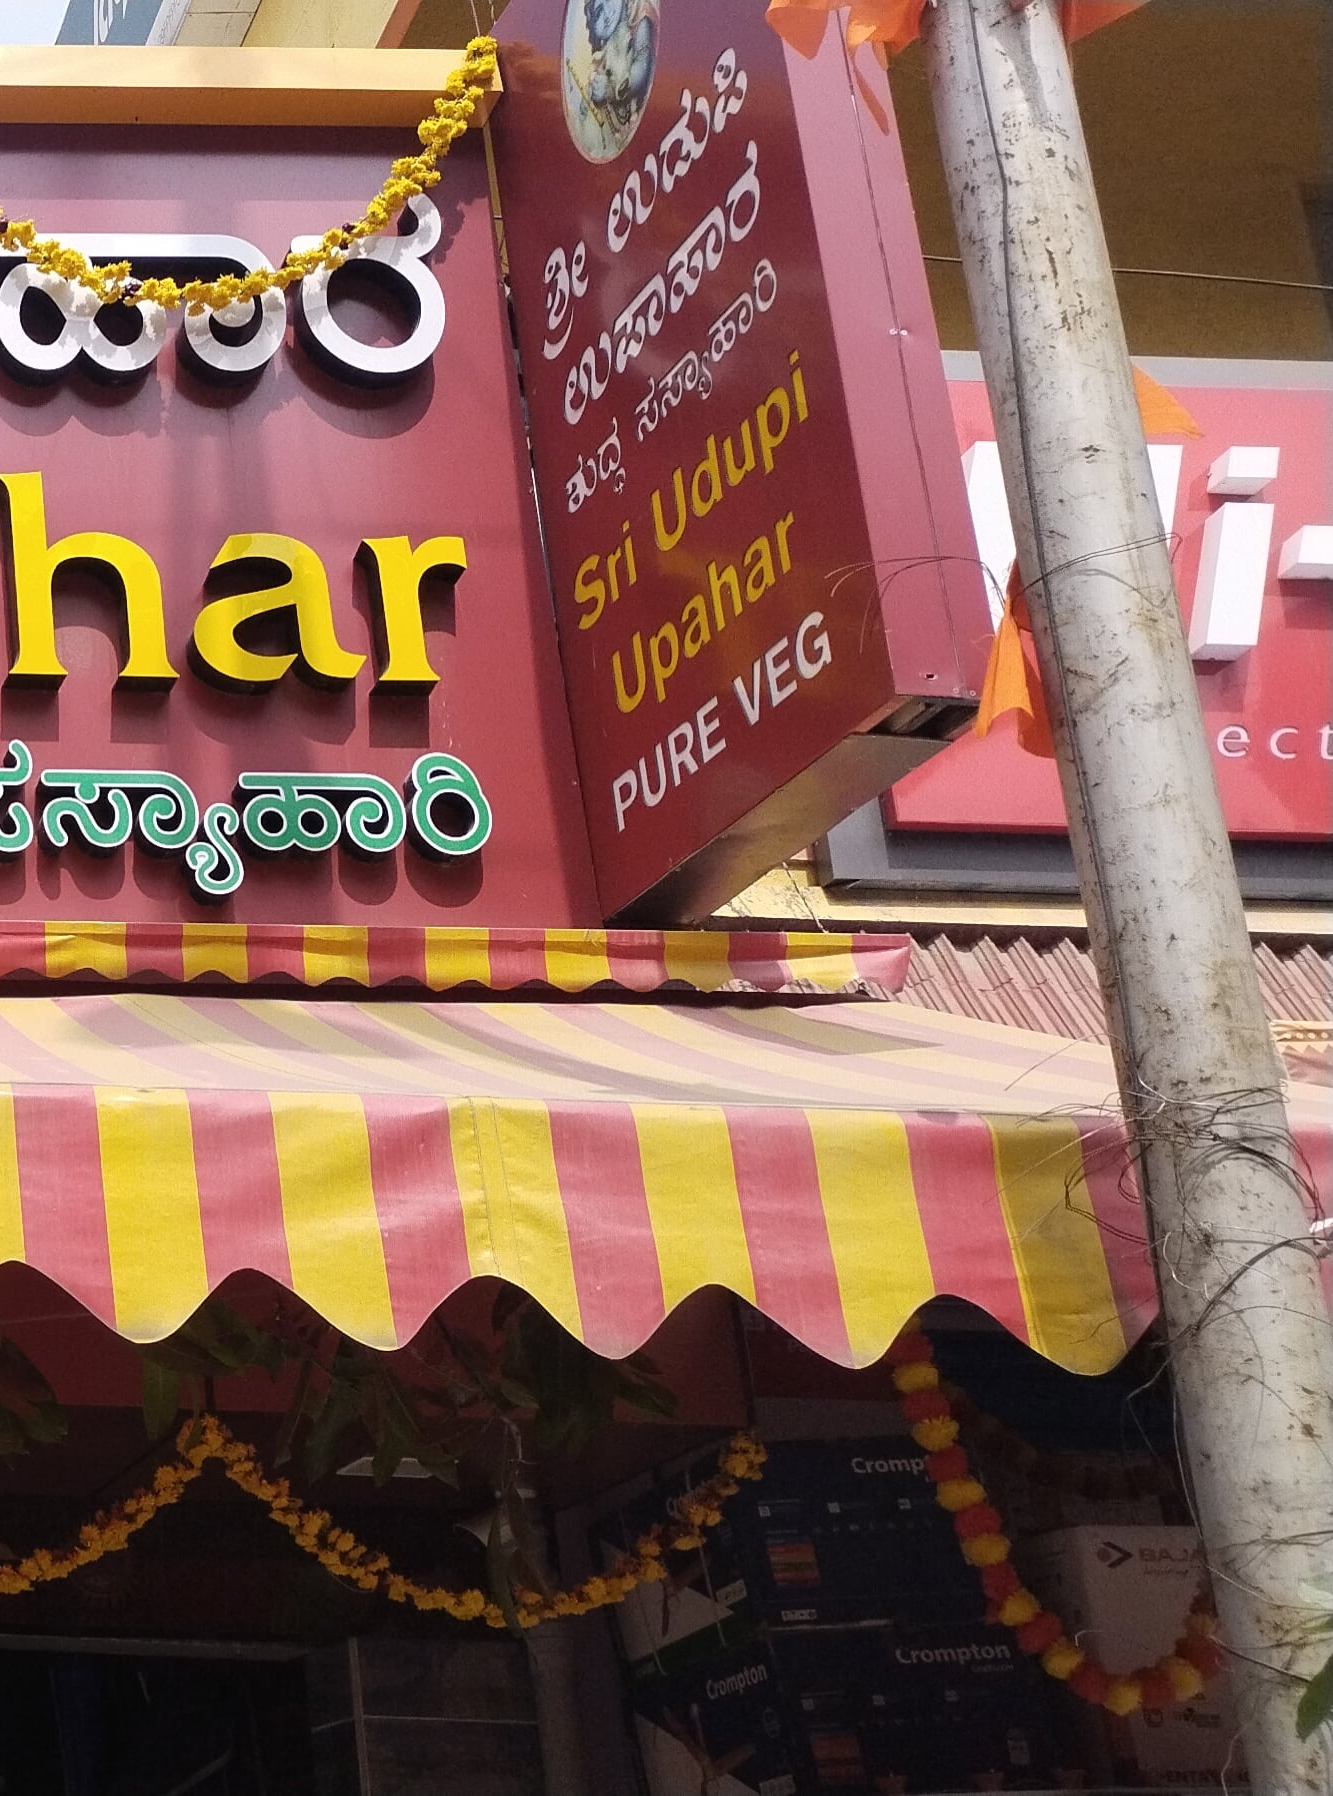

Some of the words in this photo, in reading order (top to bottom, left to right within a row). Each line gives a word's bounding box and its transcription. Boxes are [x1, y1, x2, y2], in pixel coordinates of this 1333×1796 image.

[542, 239, 589, 361] ಶ್ರೀ
[606, 46, 748, 254] ಉಡುಪಿ
[573, 519, 637, 632] Sri
[650, 350, 810, 553] Udupi
[610, 510, 796, 714] Upahar
[610, 695, 728, 833] PURE
[732, 610, 833, 727] VEG
[706, 1663, 769, 1700] Crompton
[895, 1642, 1012, 1666] Crompton
